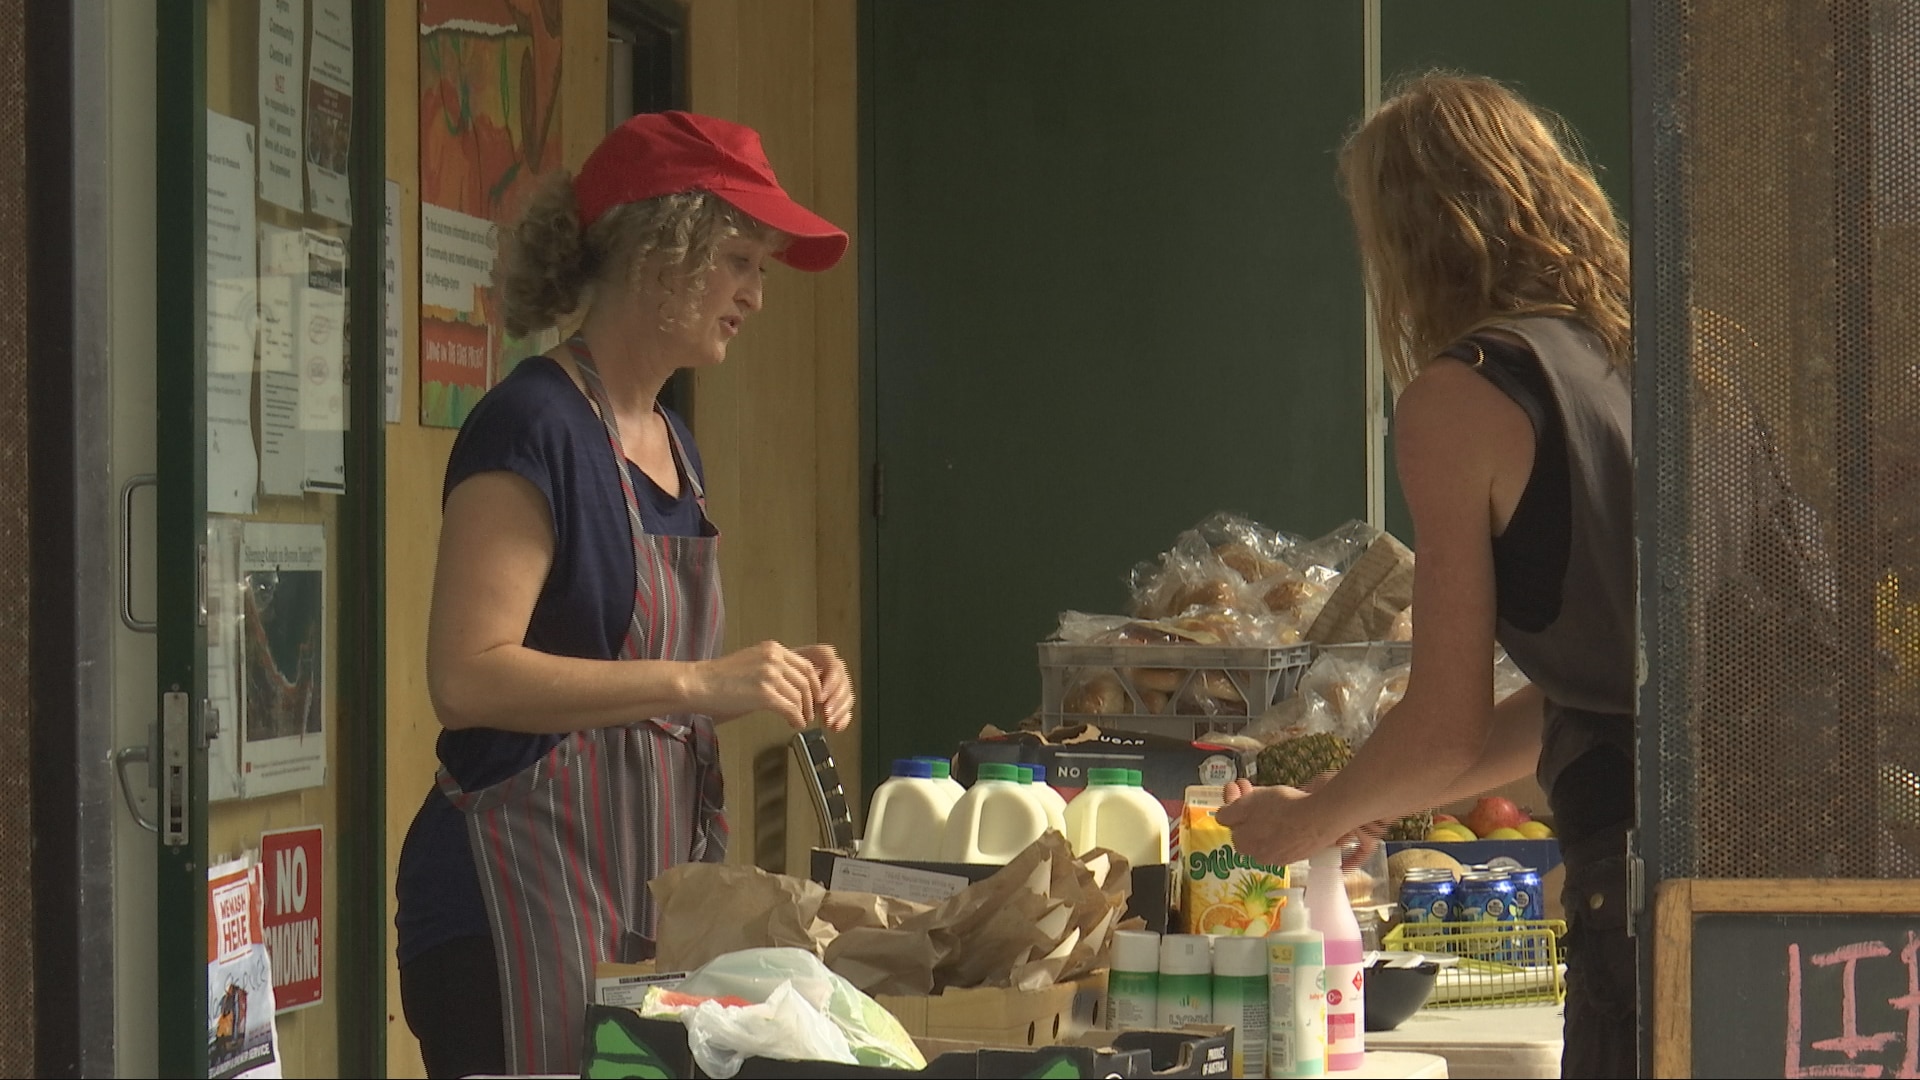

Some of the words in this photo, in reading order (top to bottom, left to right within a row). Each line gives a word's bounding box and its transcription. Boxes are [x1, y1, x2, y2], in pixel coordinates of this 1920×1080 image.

[1099, 736, 1145, 746] UGAR
[1057, 766, 1080, 778] NO
[277, 846, 308, 916] NO
[223, 914, 248, 953] HERE
[264, 917, 319, 988] SMOKING
